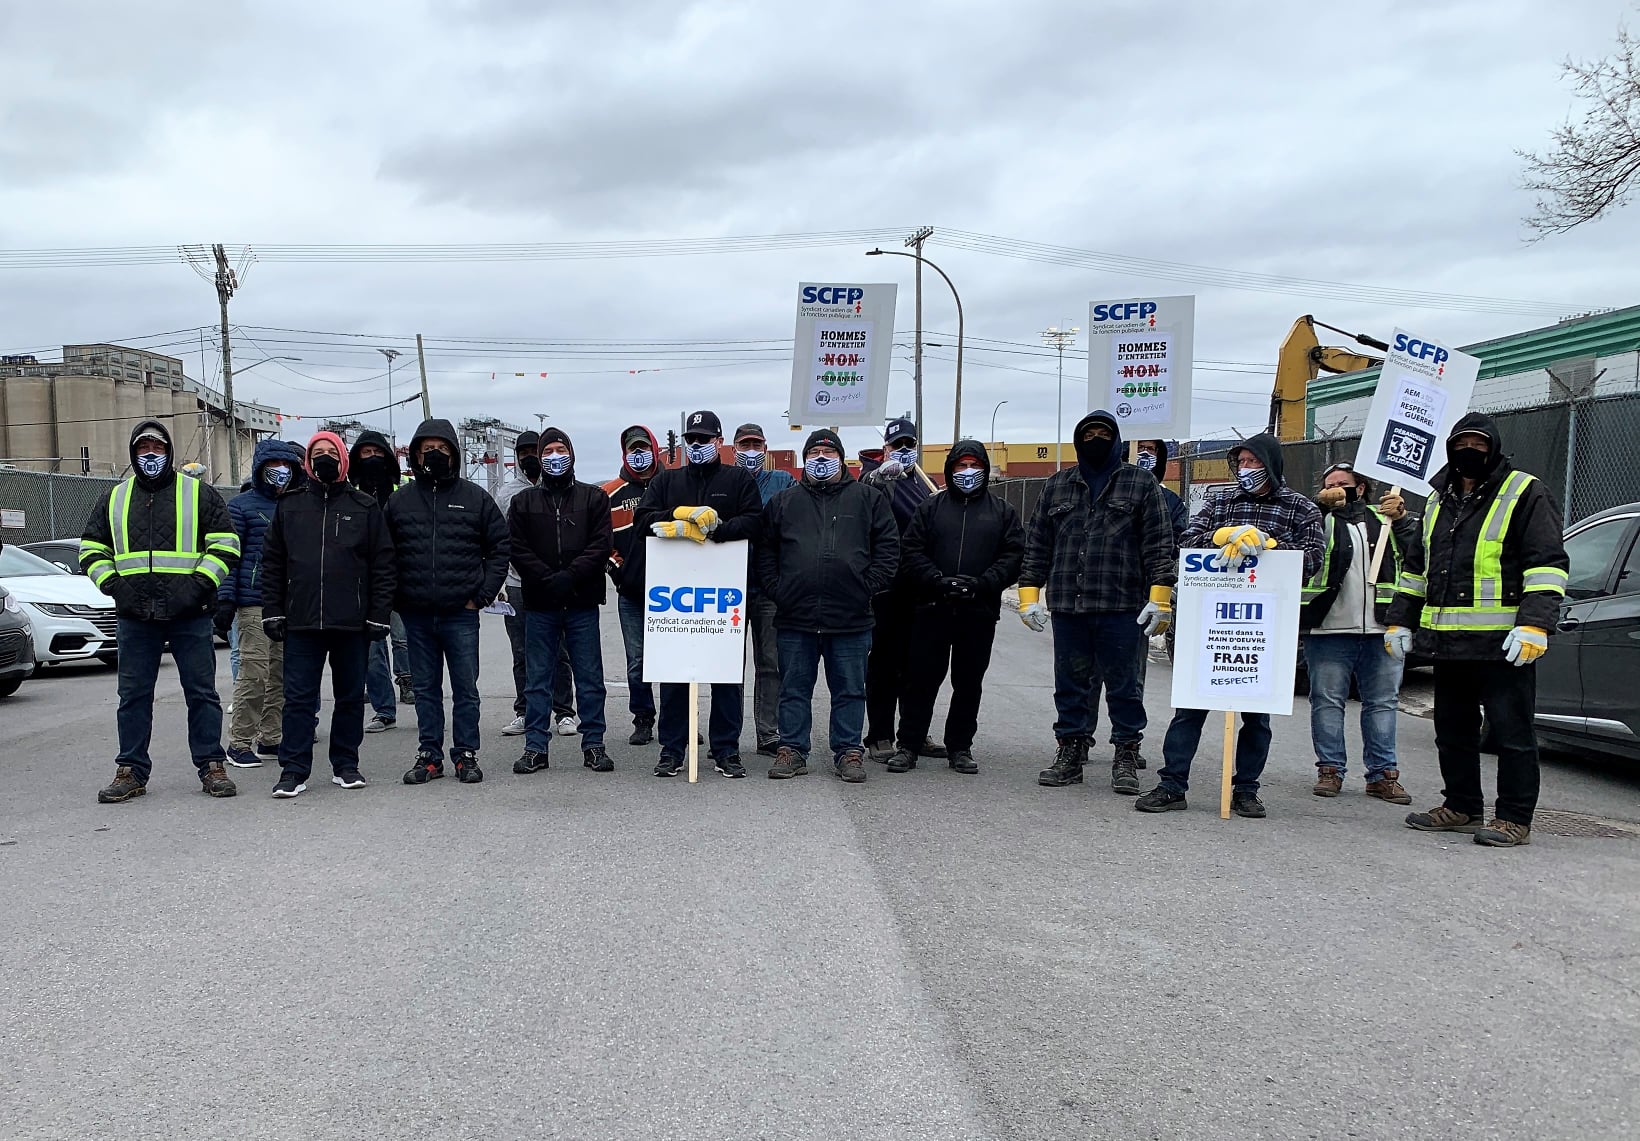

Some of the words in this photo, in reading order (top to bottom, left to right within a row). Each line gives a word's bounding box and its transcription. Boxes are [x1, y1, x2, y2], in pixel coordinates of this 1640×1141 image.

[802, 286, 864, 305] SCFP
[1093, 302, 1156, 321] SCFP
[821, 330, 866, 340] HOMMES
[1118, 342, 1166, 352] HOMMES
[1394, 334, 1448, 364] SCFP
[824, 353, 858, 366] NON
[1118, 352, 1166, 360] D'ENTRETIEN
[1390, 352, 1408, 362] Syndicat
[1409, 358, 1430, 369] canadien
[1124, 364, 1159, 378] NON
[1394, 358, 1412, 370] fonction
[1413, 366, 1433, 377] publique
[824, 370, 856, 386] OUI
[1123, 382, 1158, 398] OUI
[1404, 388, 1420, 398] AEM
[1400, 402, 1428, 416] RESPECT
[1405, 411, 1434, 427] GUERRE!
[1387, 454, 1421, 471] SOLIDAIRES
[1185, 554, 1258, 573] SCP
[649, 586, 742, 613] SCFP
[1216, 602, 1263, 619] AEM
[647, 617, 679, 626] Syndicat
[690, 626, 724, 635] publique
[1214, 653, 1258, 664] FRAIS
[1211, 675, 1258, 685] RESPECT!
